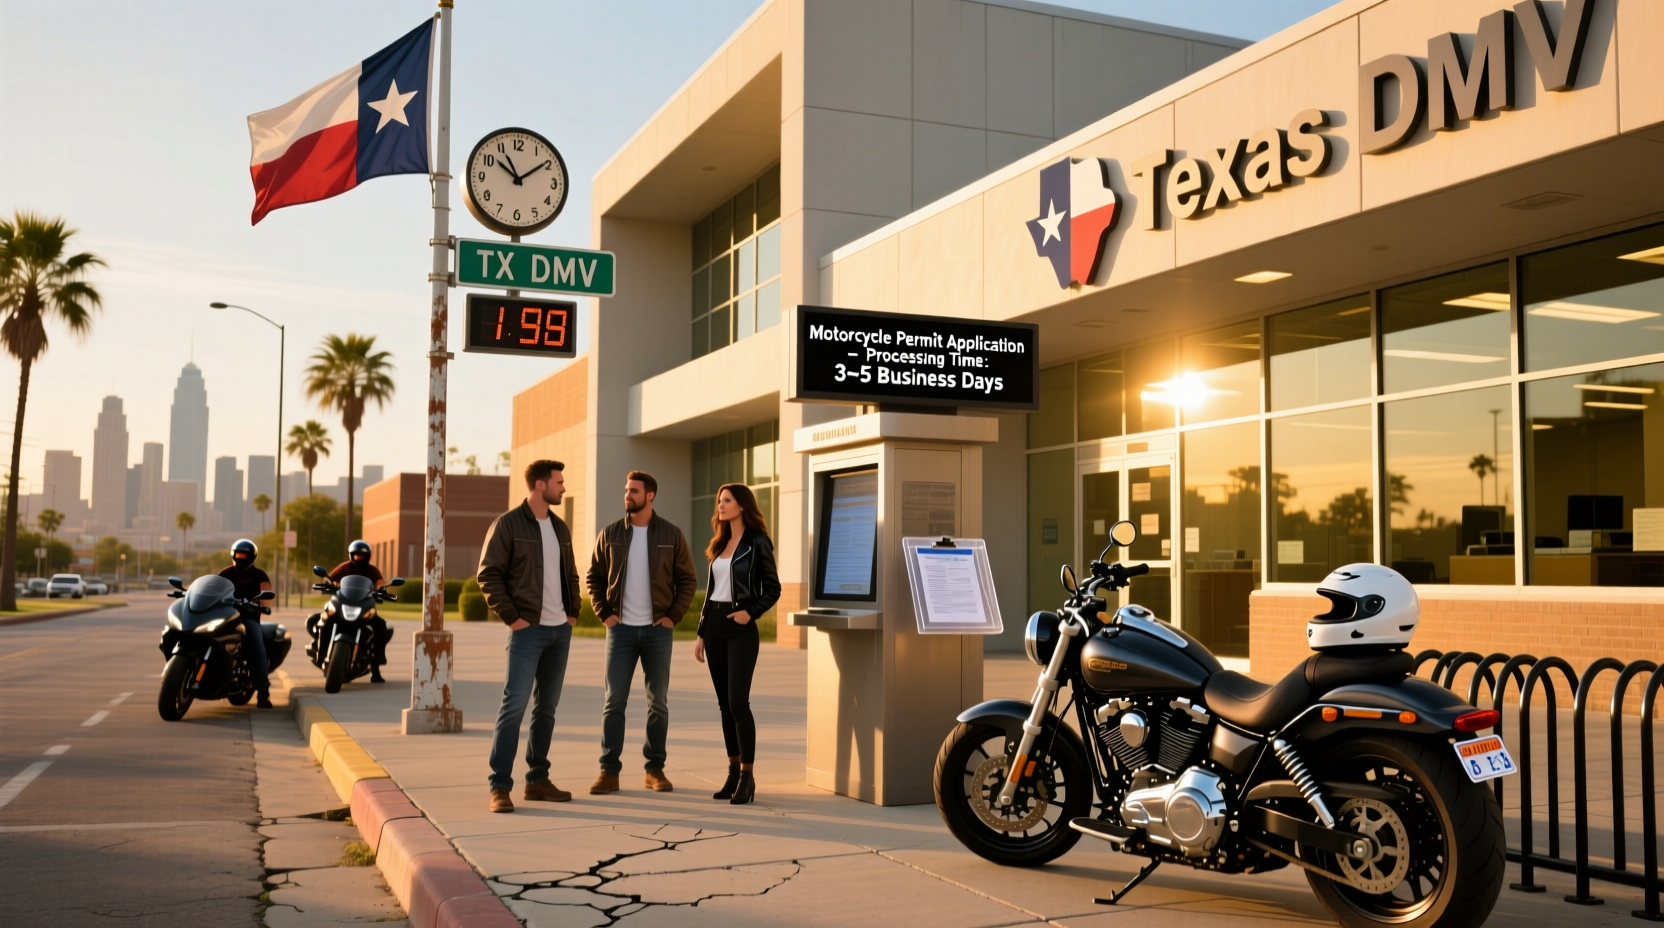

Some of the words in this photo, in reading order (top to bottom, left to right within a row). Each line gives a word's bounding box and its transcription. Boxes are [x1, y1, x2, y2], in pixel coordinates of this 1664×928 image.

[1131, 108, 1331, 231] Texas
[1360, 0, 1597, 155] DMV
[513, 139, 525, 152] 12
[484, 154, 495, 167] 10
[478, 171, 486, 183] 9
[550, 178, 558, 190] 3
[483, 189, 491, 202] 8
[543, 195, 551, 206] 4
[496, 204, 504, 216] 7
[513, 208, 521, 221] 6
[531, 207, 539, 219] 5
[477, 249, 514, 280] TX
[531, 254, 598, 288] DMV
[809, 324, 892, 347] Motorcycle
[896, 331, 943, 349] Permit
[946, 334, 1025, 354] Application
[866, 347, 945, 369] Processing
[949, 351, 989, 368] Time:
[877, 366, 957, 388] Business
[962, 371, 1004, 394] Days
